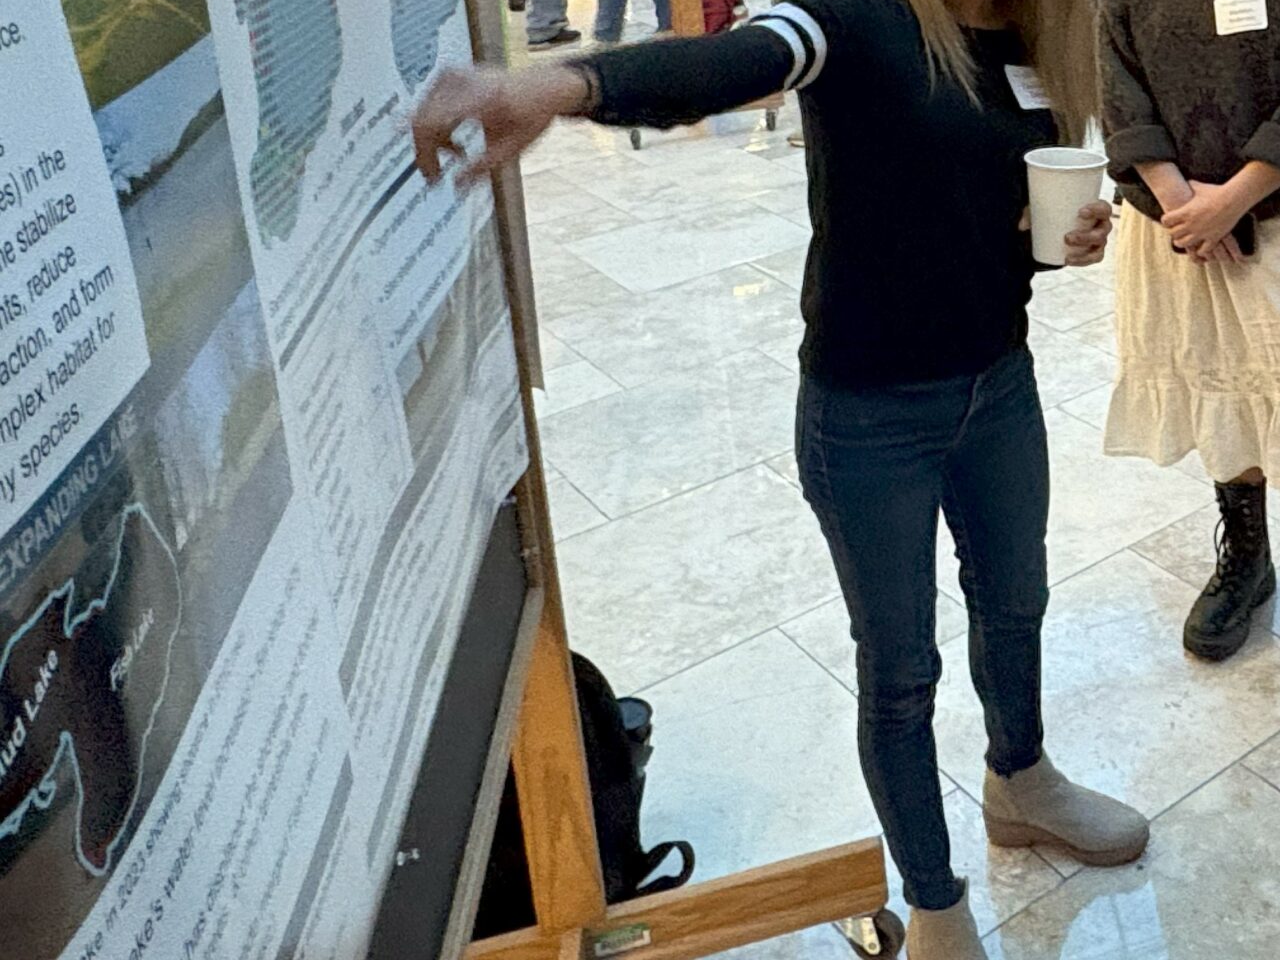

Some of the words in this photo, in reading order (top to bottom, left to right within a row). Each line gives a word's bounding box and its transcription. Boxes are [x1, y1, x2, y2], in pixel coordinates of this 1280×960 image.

[20, 166, 39, 194] in
[38, 150, 66, 181] the
[16, 193, 76, 253] stabilize
[26, 246, 76, 302] reduce
[52, 288, 81, 334] and
[79, 265, 114, 306] form
[46, 328, 98, 395] habitat
[97, 311, 115, 344] for
[0, 715, 27, 776] ud
[24, 649, 58, 722] Lake
